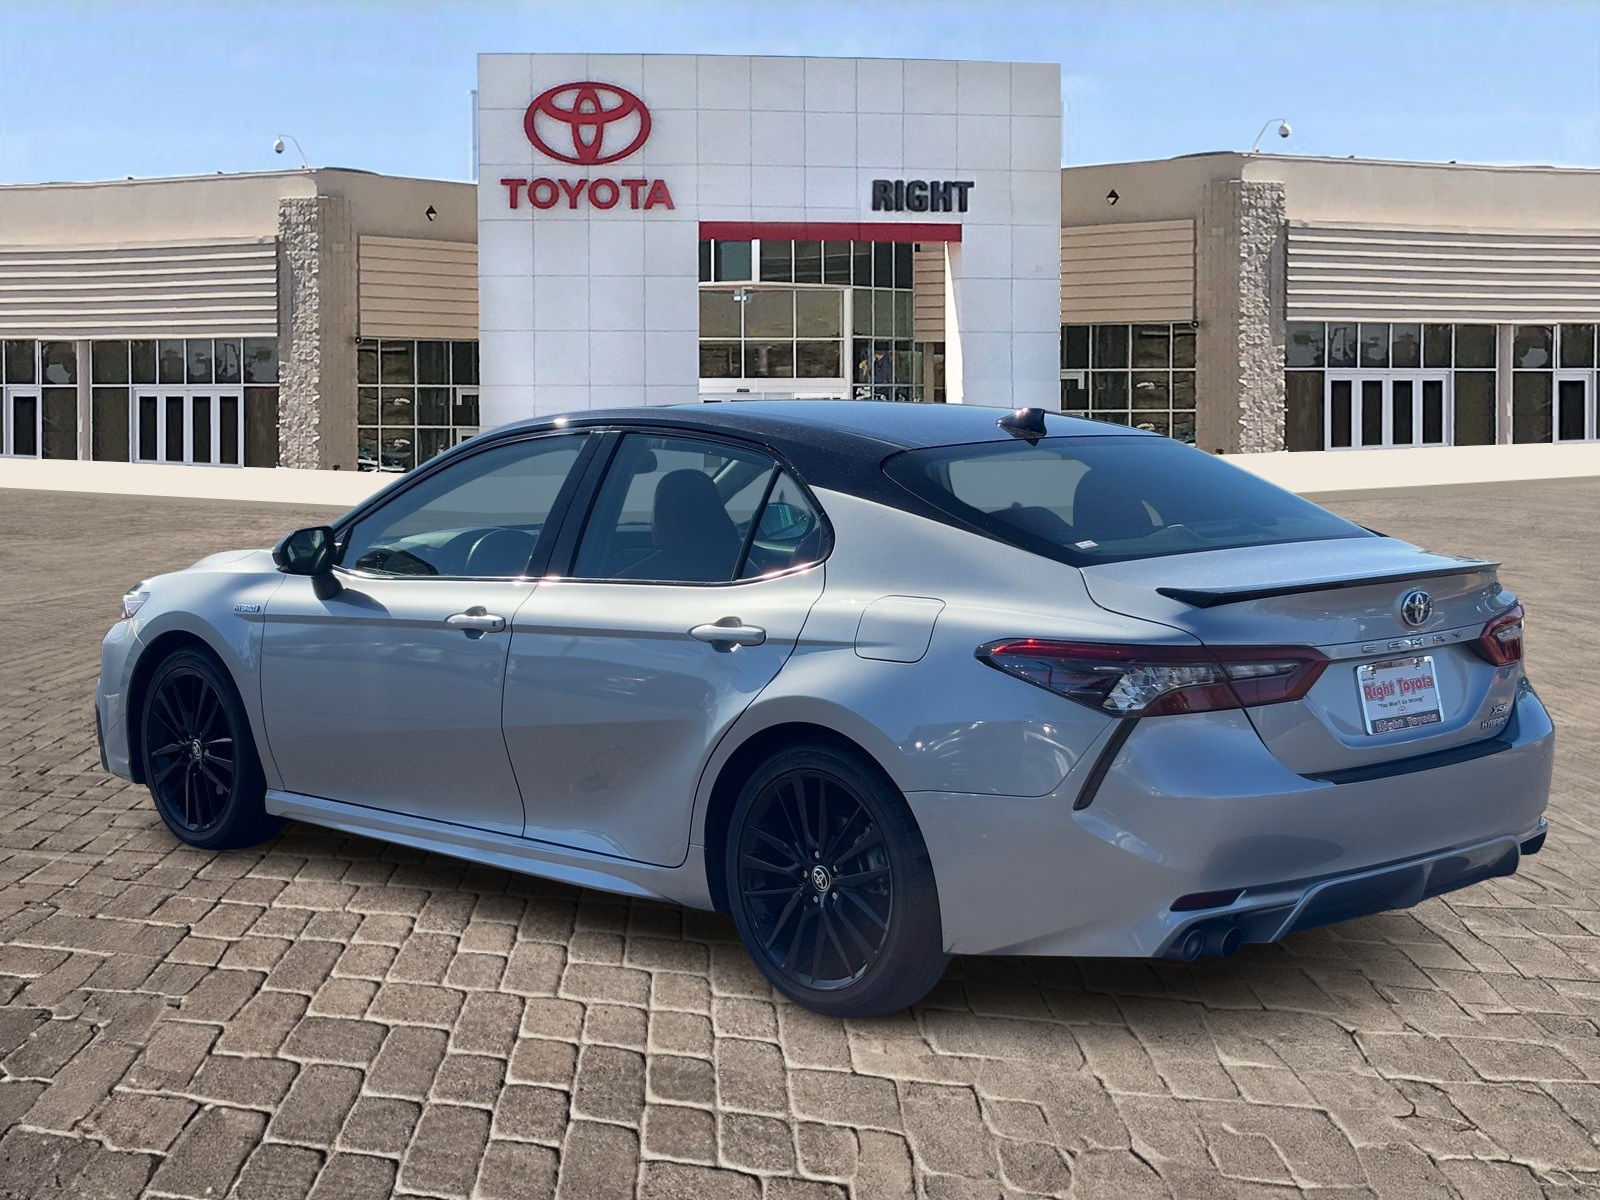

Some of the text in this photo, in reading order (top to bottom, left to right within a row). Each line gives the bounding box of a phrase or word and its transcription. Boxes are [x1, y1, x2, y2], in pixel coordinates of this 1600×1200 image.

[500, 178, 675, 210] TOYOTA
[871, 179, 975, 213] RIGHT
[1362, 632, 1461, 653] CAMRY
[1363, 674, 1434, 702] Right Toyota
[1491, 703, 1508, 715] XSE
[1375, 713, 1438, 733] Right Toyota
